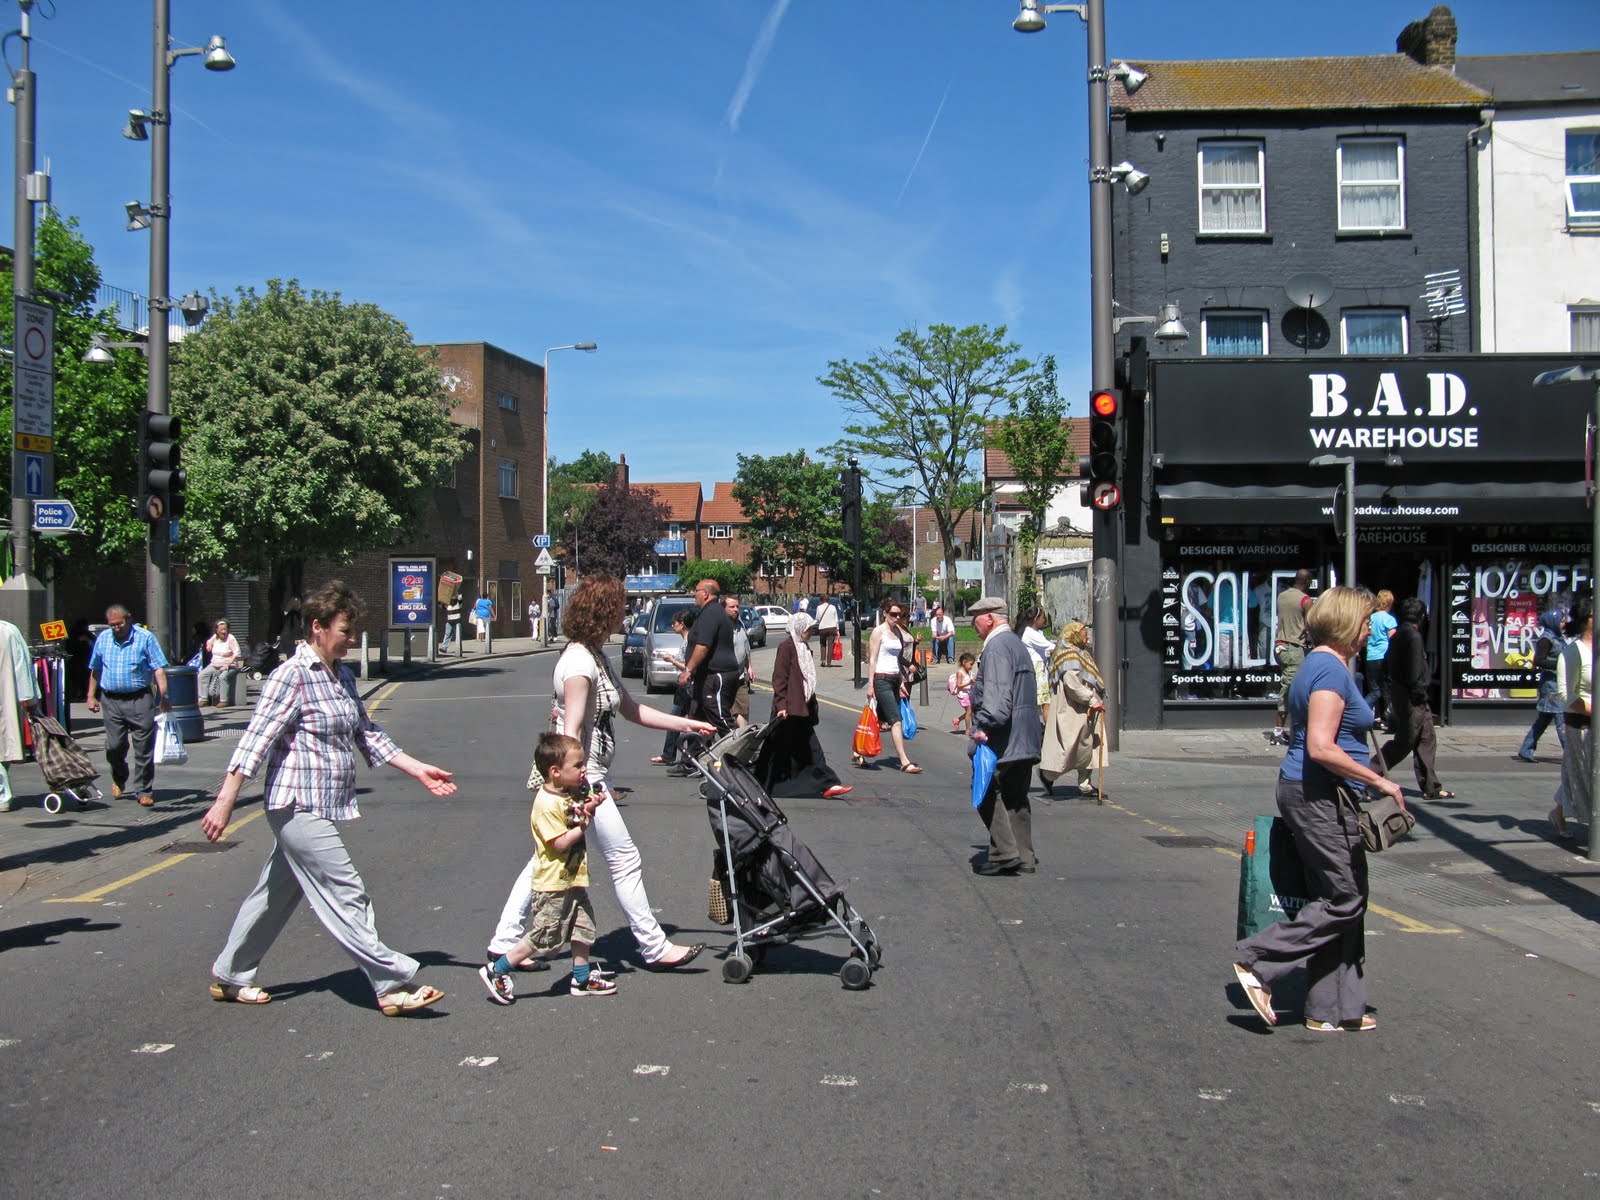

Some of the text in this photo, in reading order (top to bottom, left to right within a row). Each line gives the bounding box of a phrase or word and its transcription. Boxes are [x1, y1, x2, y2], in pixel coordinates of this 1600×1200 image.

[26, 313, 45, 326] ZONE
[1309, 372, 1478, 417] B.A.D.
[1309, 427, 1479, 448] WAREHOUSE
[38, 507, 63, 516] Police
[38, 516, 63, 525] Office
[541, 537, 547, 546] P
[1355, 531, 1428, 544] AREHOUSE
[1180, 544, 1300, 555] DESIGNER WAREHOUSE
[1471, 543, 1593, 553] DESIGNER WAREHOUSE
[1474, 561, 1590, 599] 10% OFF
[45, 623, 66, 639] £2
[1171, 674, 1204, 685] Sports
[1245, 674, 1272, 683] Store
[1461, 673, 1494, 684] Sports
